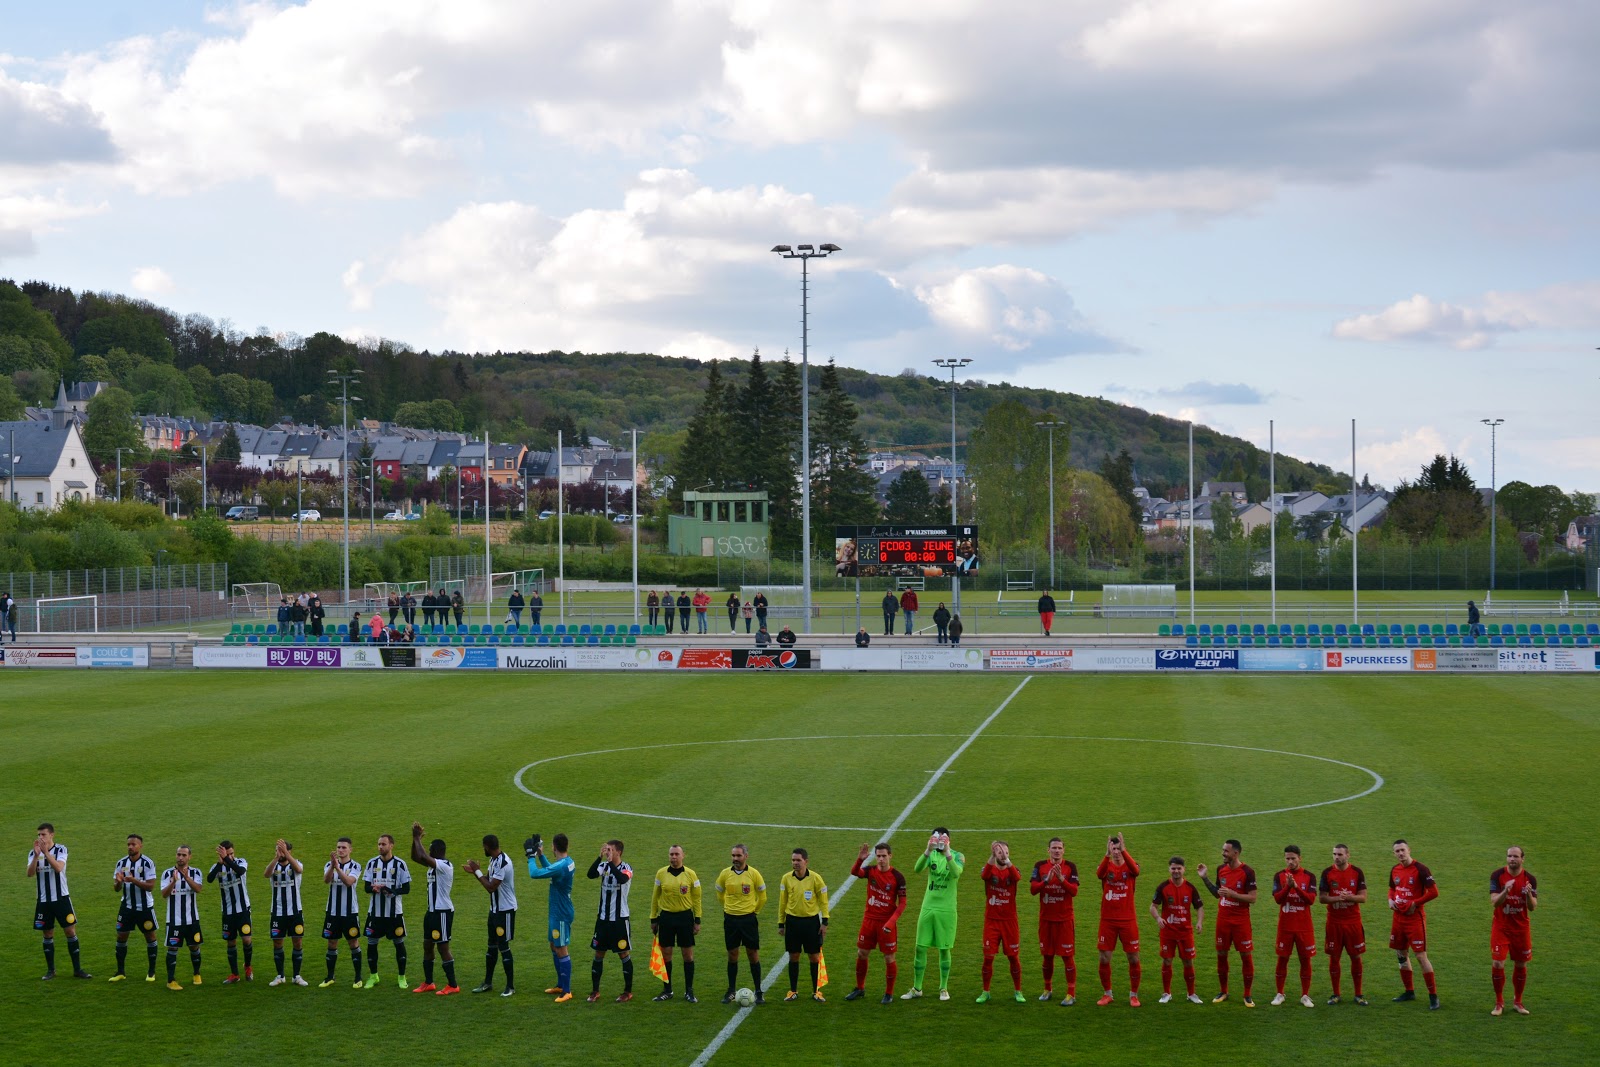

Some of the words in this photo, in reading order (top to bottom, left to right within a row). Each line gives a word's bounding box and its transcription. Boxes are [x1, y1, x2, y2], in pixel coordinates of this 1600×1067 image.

[880, 541, 911, 550] FCD03
[923, 541, 954, 550] JEUNE
[880, 552, 887, 561] 0
[904, 552, 936, 561] 00:00
[947, 552, 954, 561] 0
[270, 650, 286, 660] BIL
[293, 650, 309, 660] BIL
[316, 650, 332, 660] BIL
[1180, 650, 1235, 659] HYUNDAI
[506, 655, 567, 668] Muzzolini
[746, 655, 778, 668] MAX
[1344, 656, 1408, 664] SPUERKEESS
